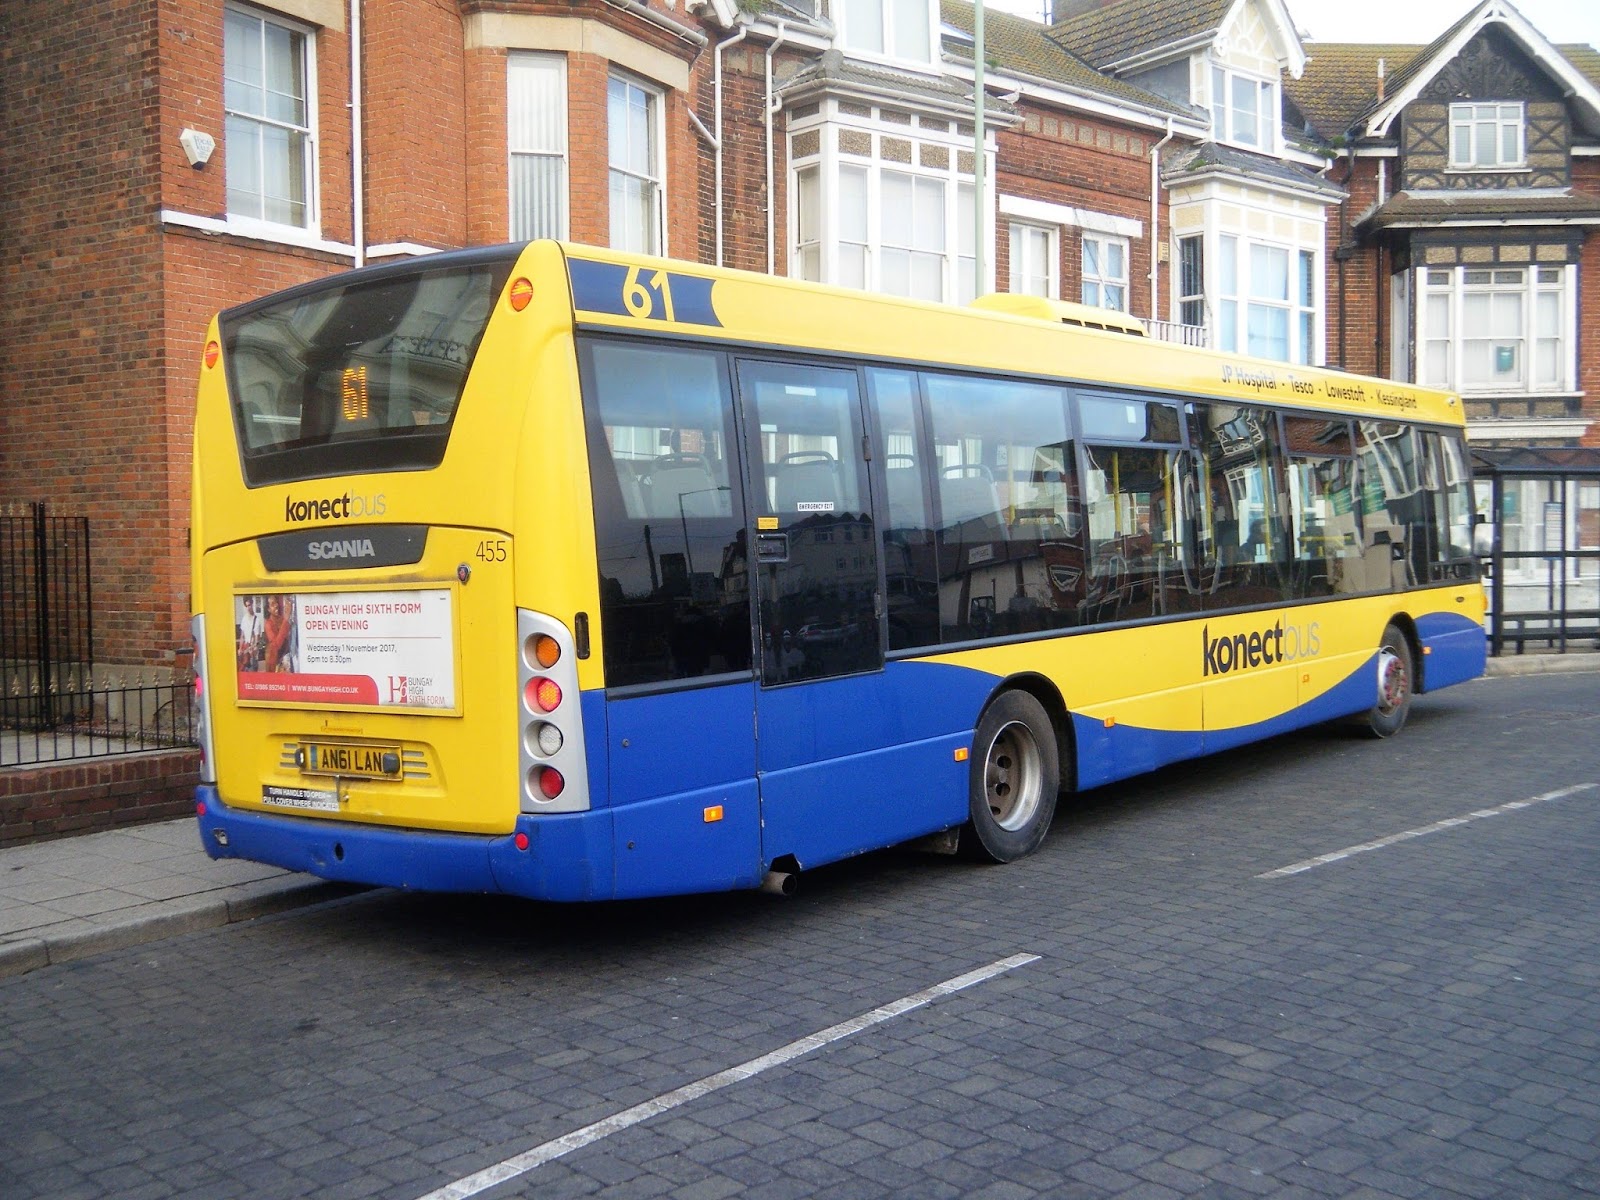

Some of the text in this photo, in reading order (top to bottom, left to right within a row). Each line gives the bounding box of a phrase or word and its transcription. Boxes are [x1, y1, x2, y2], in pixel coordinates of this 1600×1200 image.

[622, 266, 675, 322] 61
[343, 366, 367, 420] 61
[1221, 365, 1418, 411] JP Hospital Tesco Lowestoft Kessingland
[285, 488, 387, 522] konectbus
[308, 539, 376, 560] SCANIA
[475, 540, 507, 562] 455
[305, 603, 422, 615] BUNGAY HIGH SIXTH FORM
[305, 620, 369, 630] OPEN EVENING
[306, 644, 341, 654] Wednesday
[345, 644, 378, 652] November
[1203, 612, 1321, 677] konectbus
[307, 655, 320, 663] 6pm
[292, 685, 359, 694] WWW.BUNGAYHIGH.CO.UK
[408, 677, 433, 687] BUNGAY
[408, 687, 424, 695] HIGH
[409, 696, 445, 705] SIXTH FORM
[354, 750, 382, 772] LAN
